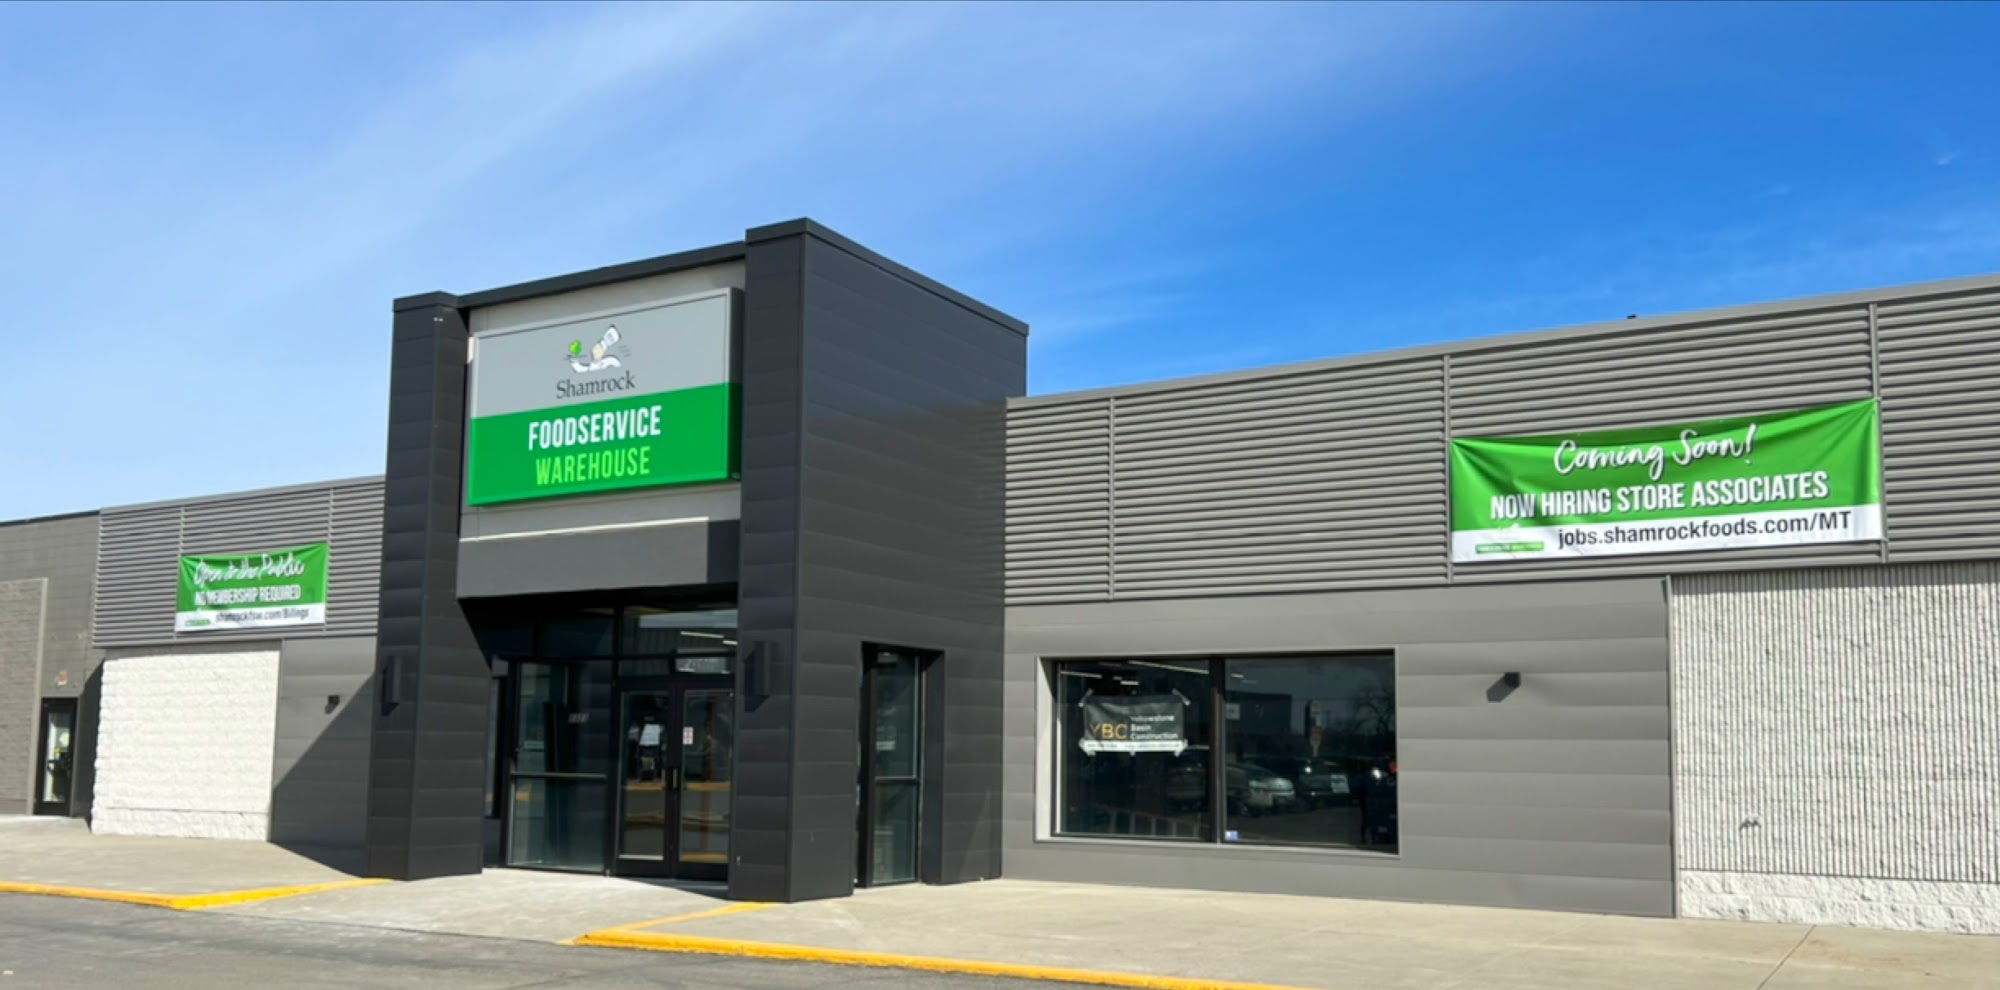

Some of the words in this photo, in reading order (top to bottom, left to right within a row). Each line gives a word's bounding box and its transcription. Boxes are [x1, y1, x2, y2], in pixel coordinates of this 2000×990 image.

[556, 370, 636, 399] Shamrock
[528, 405, 662, 451] FOODSERVICE
[536, 446, 651, 486] WAREHOUSE
[1554, 439, 1665, 481] Coming
[1672, 424, 1757, 465] Soon!
[1490, 494, 1537, 520] NOW
[1541, 487, 1612, 517] HIRING
[1616, 482, 1684, 513] STORE
[1692, 471, 1829, 508] ASSOCIATES
[1557, 511, 1852, 550] jobs.shamrockfoods.com/MT
[207, 588, 258, 605] MEMBERSHIP
[259, 584, 301, 602] REQUIRED
[1090, 723, 1128, 740] YBC
